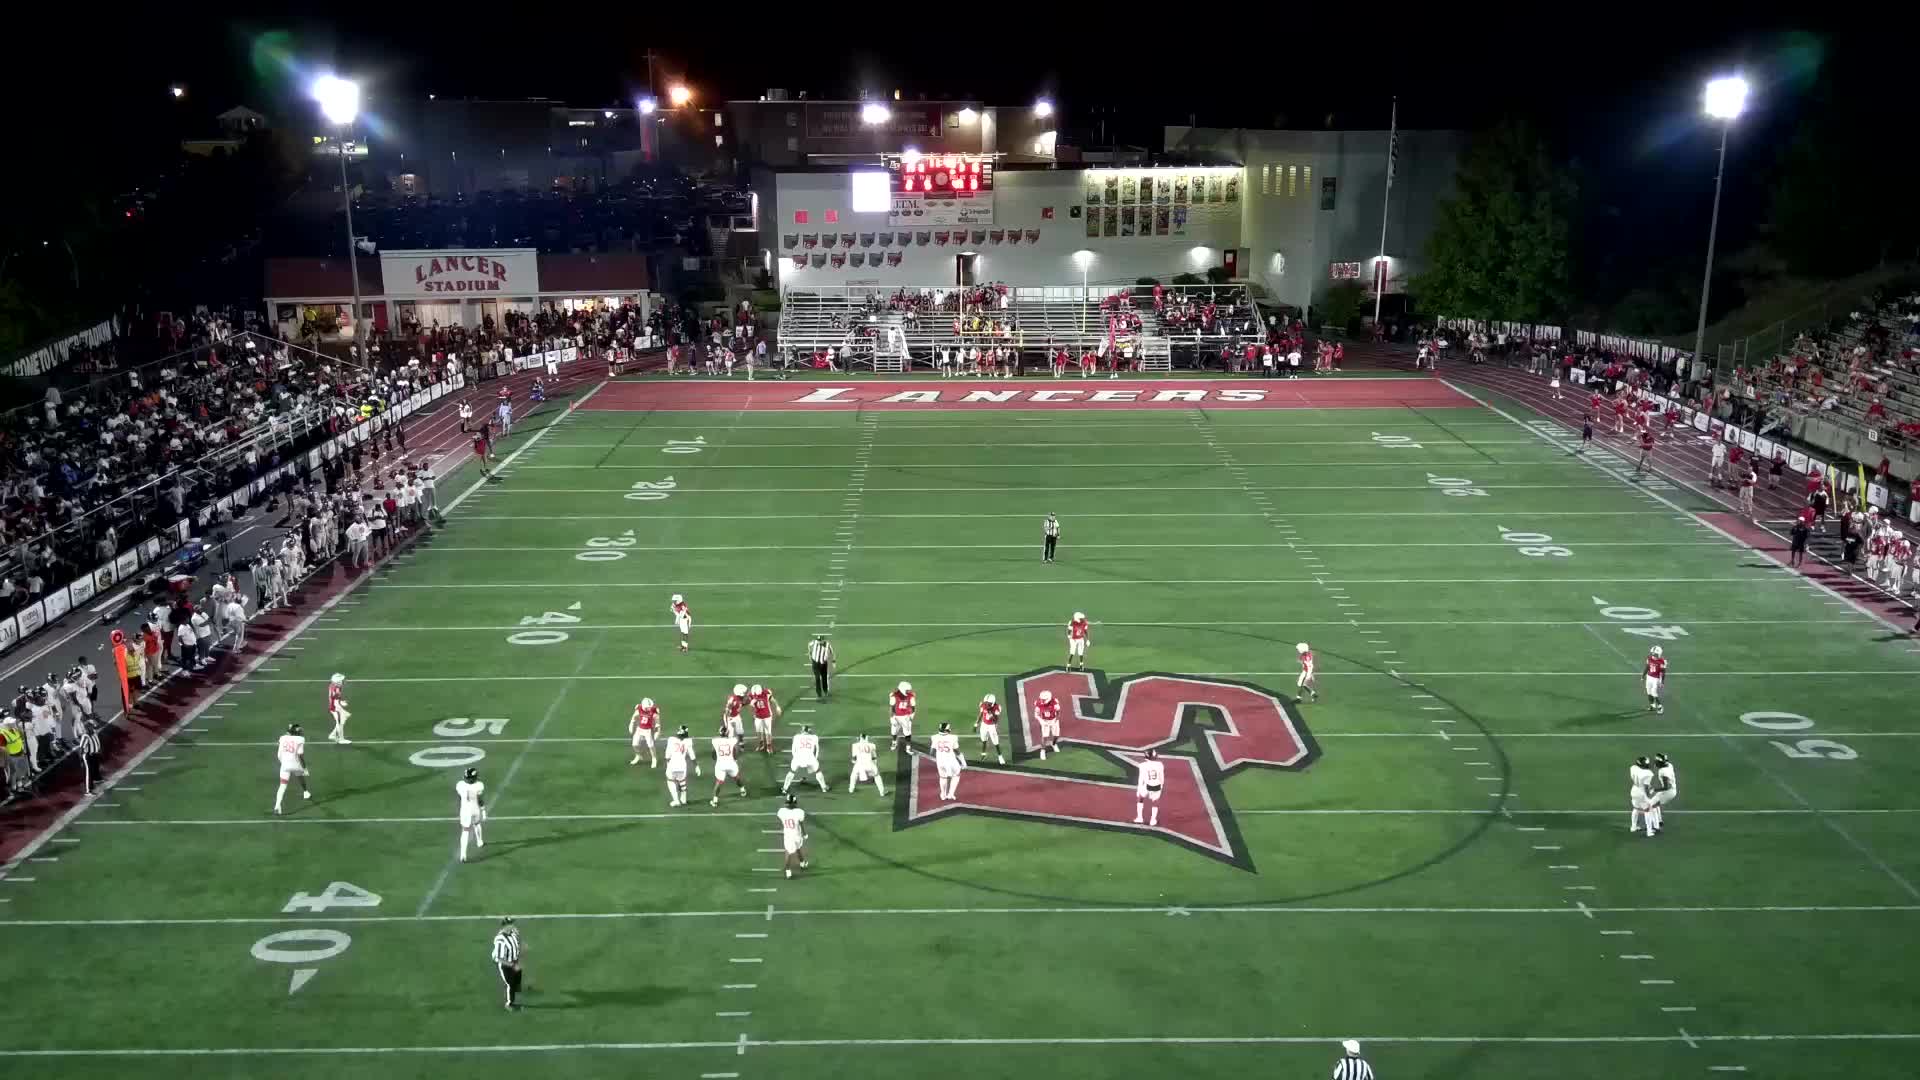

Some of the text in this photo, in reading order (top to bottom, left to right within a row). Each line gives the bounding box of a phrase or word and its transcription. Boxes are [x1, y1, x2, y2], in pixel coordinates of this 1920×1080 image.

[416, 256, 507, 283] LANCER
[424, 280, 500, 291] STADIUM
[793, 388, 1268, 403] LANCERS
[661, 439, 706, 455] 10
[1372, 434, 1423, 449] 10
[624, 480, 677, 501] 20
[1428, 477, 1491, 497] 20
[575, 536, 637, 562] 30
[1500, 532, 1576, 557] 30
[506, 610, 582, 646] 40
[1599, 606, 1690, 641] 40
[409, 716, 510, 768] 50
[1738, 711, 1859, 761] 50
[250, 880, 383, 963] 40
